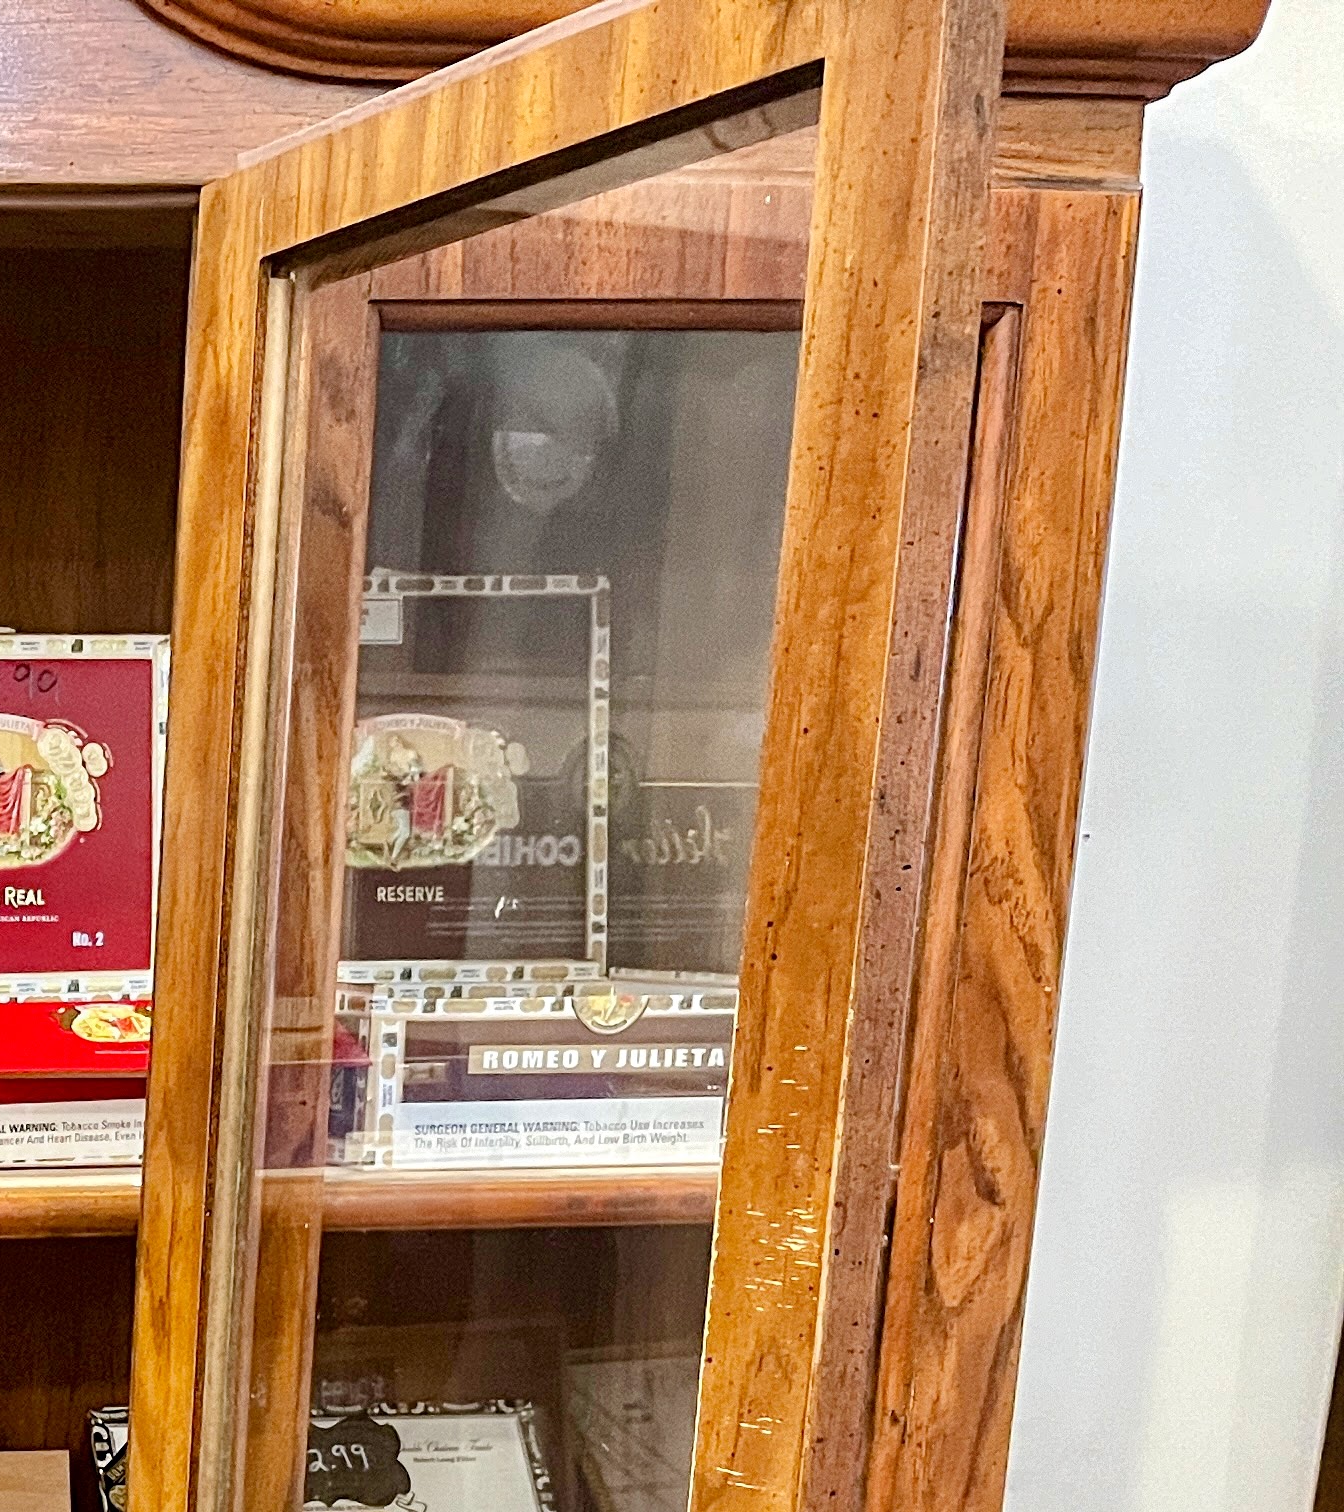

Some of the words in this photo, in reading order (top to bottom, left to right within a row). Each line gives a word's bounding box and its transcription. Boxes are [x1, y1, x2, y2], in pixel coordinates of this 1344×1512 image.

[3, 886, 46, 907] REAL
[376, 886, 445, 904] RESERVE
[95, 931, 104, 946] 2
[482, 1048, 579, 1070] ROMEO
[590, 1048, 609, 1069] Y
[615, 1047, 725, 1069] JULIETA
